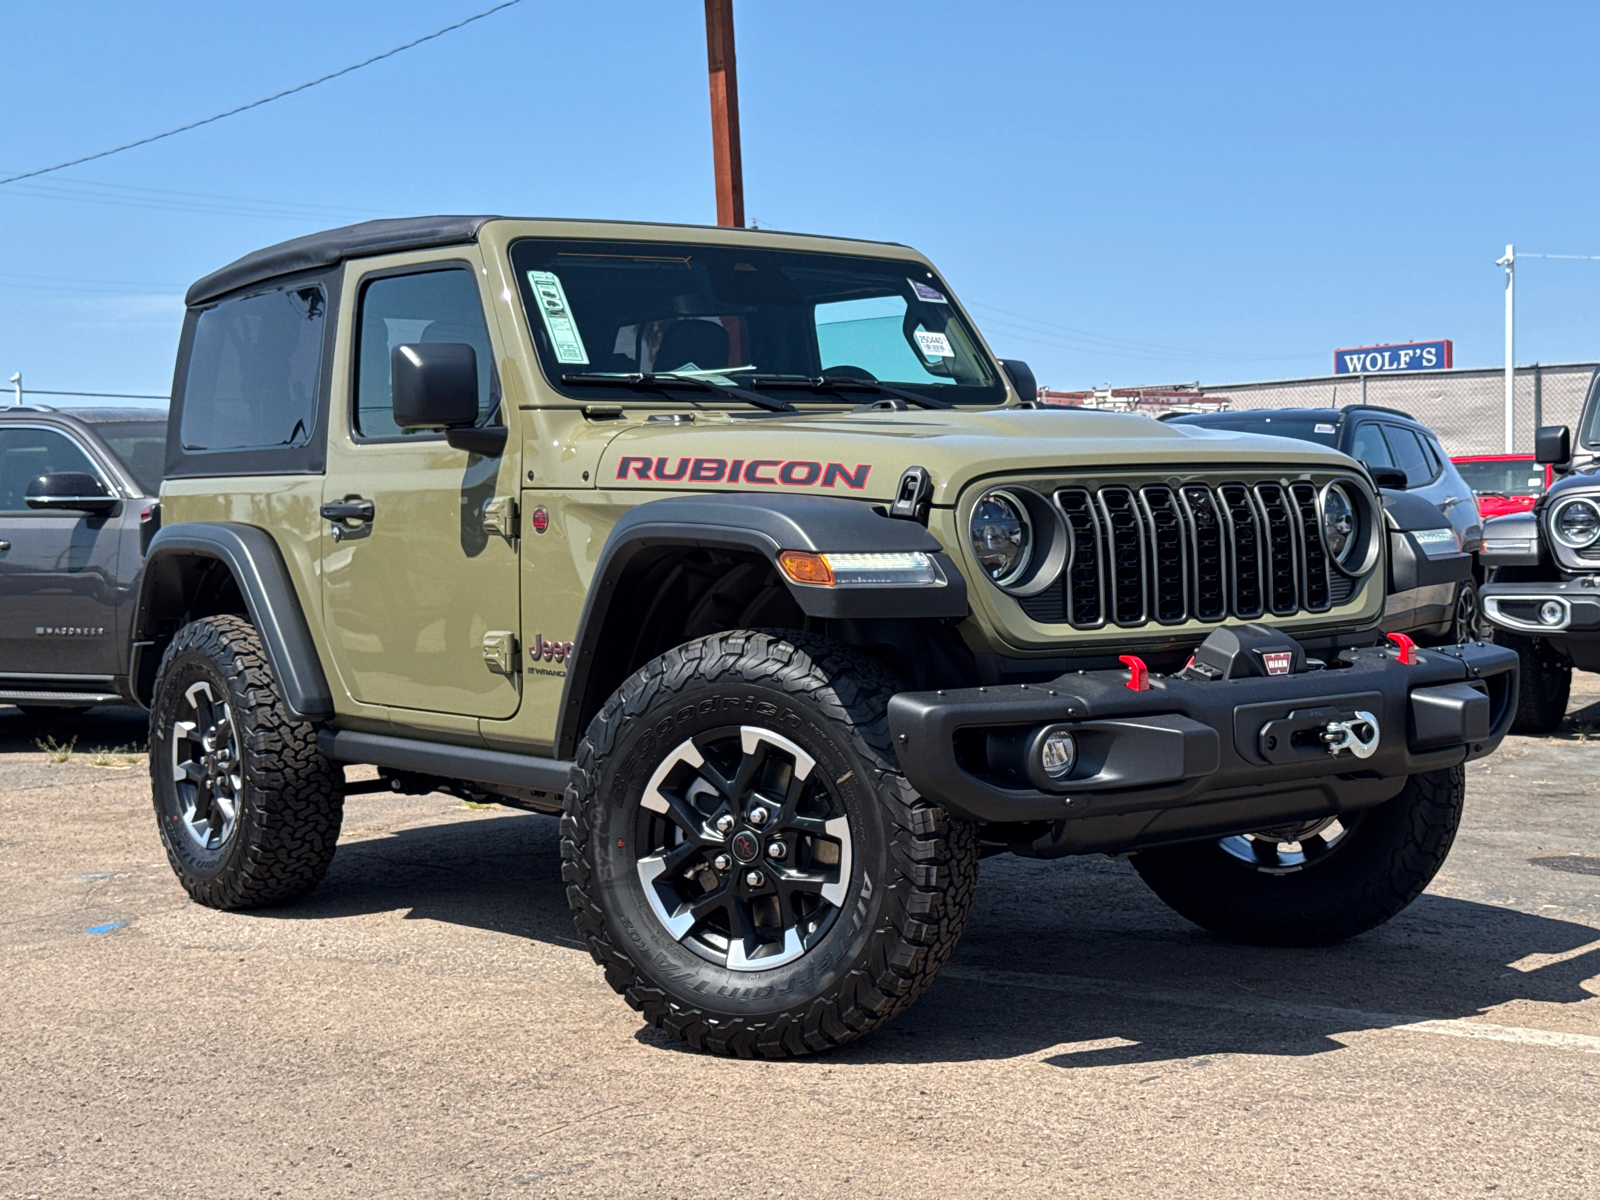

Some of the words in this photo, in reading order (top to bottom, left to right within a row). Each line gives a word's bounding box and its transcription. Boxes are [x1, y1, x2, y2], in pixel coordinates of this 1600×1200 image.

[1344, 347, 1437, 373] WOLF'S
[615, 456, 872, 490] RUBICON
[46, 626, 104, 635] WAGONEER
[1267, 659, 1288, 669] WARN
